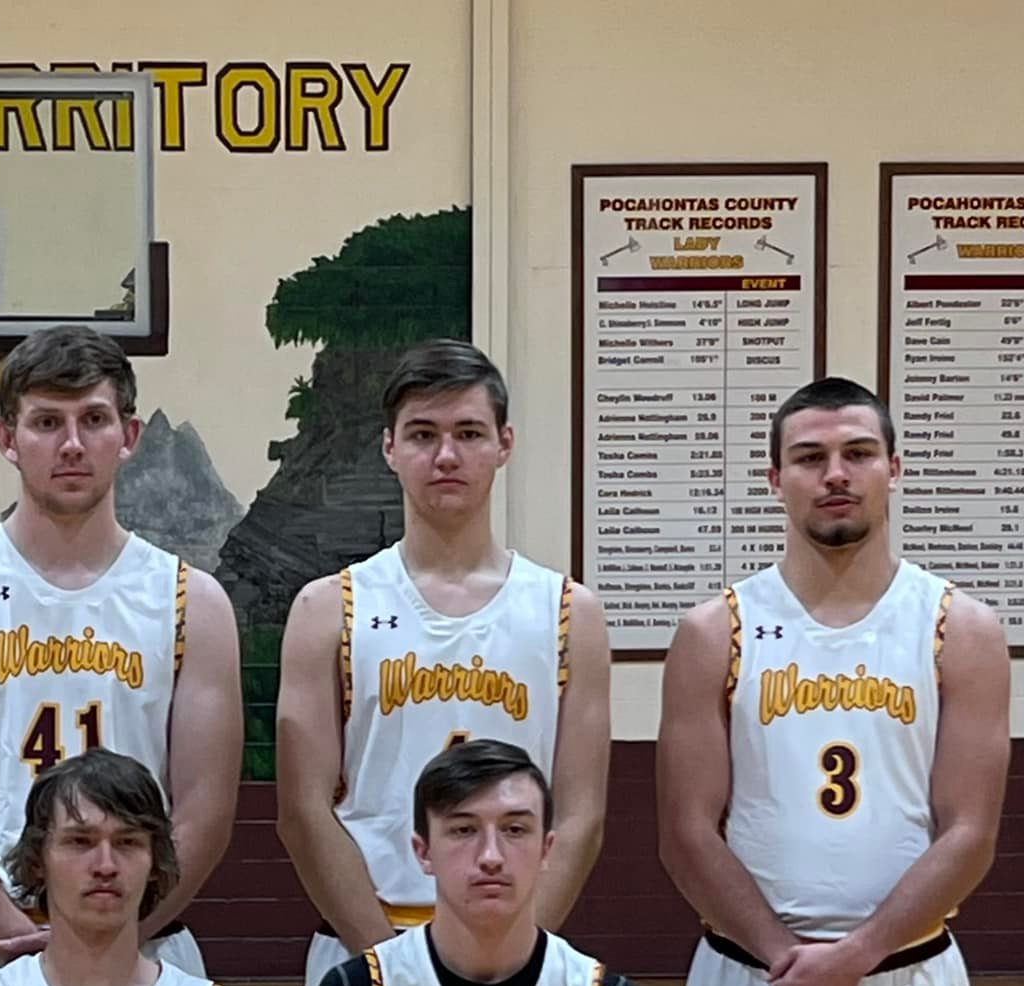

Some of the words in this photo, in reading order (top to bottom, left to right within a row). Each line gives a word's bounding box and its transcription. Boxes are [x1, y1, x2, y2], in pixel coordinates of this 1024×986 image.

[599, 198, 720, 211] POCAHONTAS
[724, 197, 799, 210] COUNTY
[624, 217, 684, 230] TRACK
[688, 217, 773, 230] RECORDS
[931, 216, 992, 229] TRACK
[673, 236, 721, 251] LADY
[649, 255, 745, 271] WARRIORS
[741, 278, 787, 289] EVENT
[736, 299, 763, 308] LONG
[742, 337, 786, 346] SHOTPUT
[746, 356, 781, 365] DISCUS
[379, 652, 529, 721] Warriors
[759, 662, 917, 726] Warriors
[20, 700, 102, 778] 41
[816, 740, 862, 821] 3
